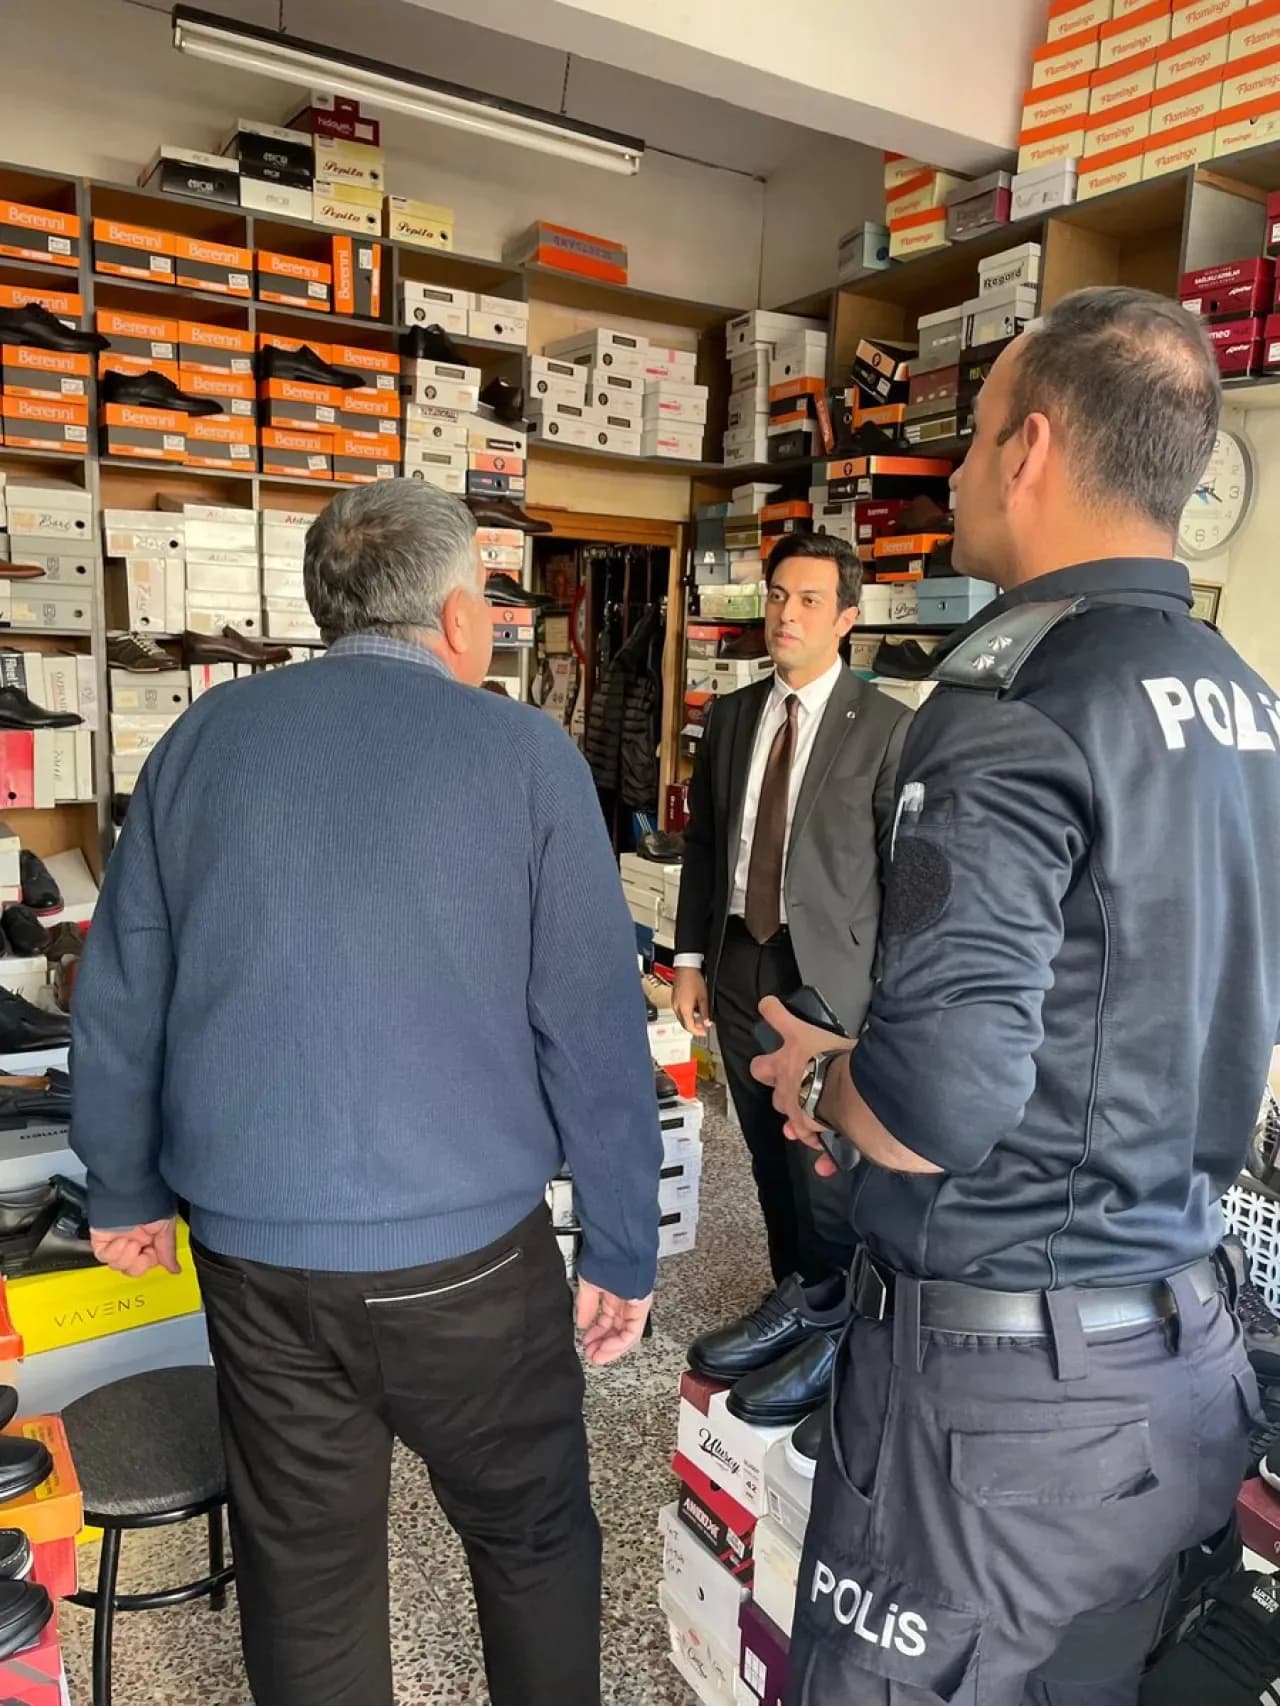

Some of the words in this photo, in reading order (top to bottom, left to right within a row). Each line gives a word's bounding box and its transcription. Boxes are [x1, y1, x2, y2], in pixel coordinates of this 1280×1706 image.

[1168, 52, 1211, 75] Flamingo
[1101, 84, 1139, 104] Flamingo
[1162, 103, 1204, 124] Flamingo
[1096, 125, 1134, 144] Flamingo
[1155, 148, 1197, 168] Flamingo
[323, 160, 364, 179] Pepita
[1088, 171, 1127, 190] Flamingo
[9, 206, 65, 232] Berenni
[321, 205, 361, 222] Pepita
[109, 227, 163, 249] Berenni
[396, 221, 434, 239] Pepita
[189, 242, 239, 265] Berenni
[272, 257, 320, 280] Berenni
[112, 316, 166, 337] Berenni
[191, 327, 241, 347] Berenni
[19, 349, 75, 370] Berenni
[344, 346, 389, 368] Berenni
[193, 376, 243, 395] Berenni
[283, 382, 330, 402] Berenni
[19, 401, 74, 421] Berenni
[344, 396, 389, 414] Berenni
[122, 408, 176, 427] Berenni
[195, 422, 243, 441] Berenni
[275, 431, 321, 451] Berenni
[344, 440, 389, 458] Berenni
